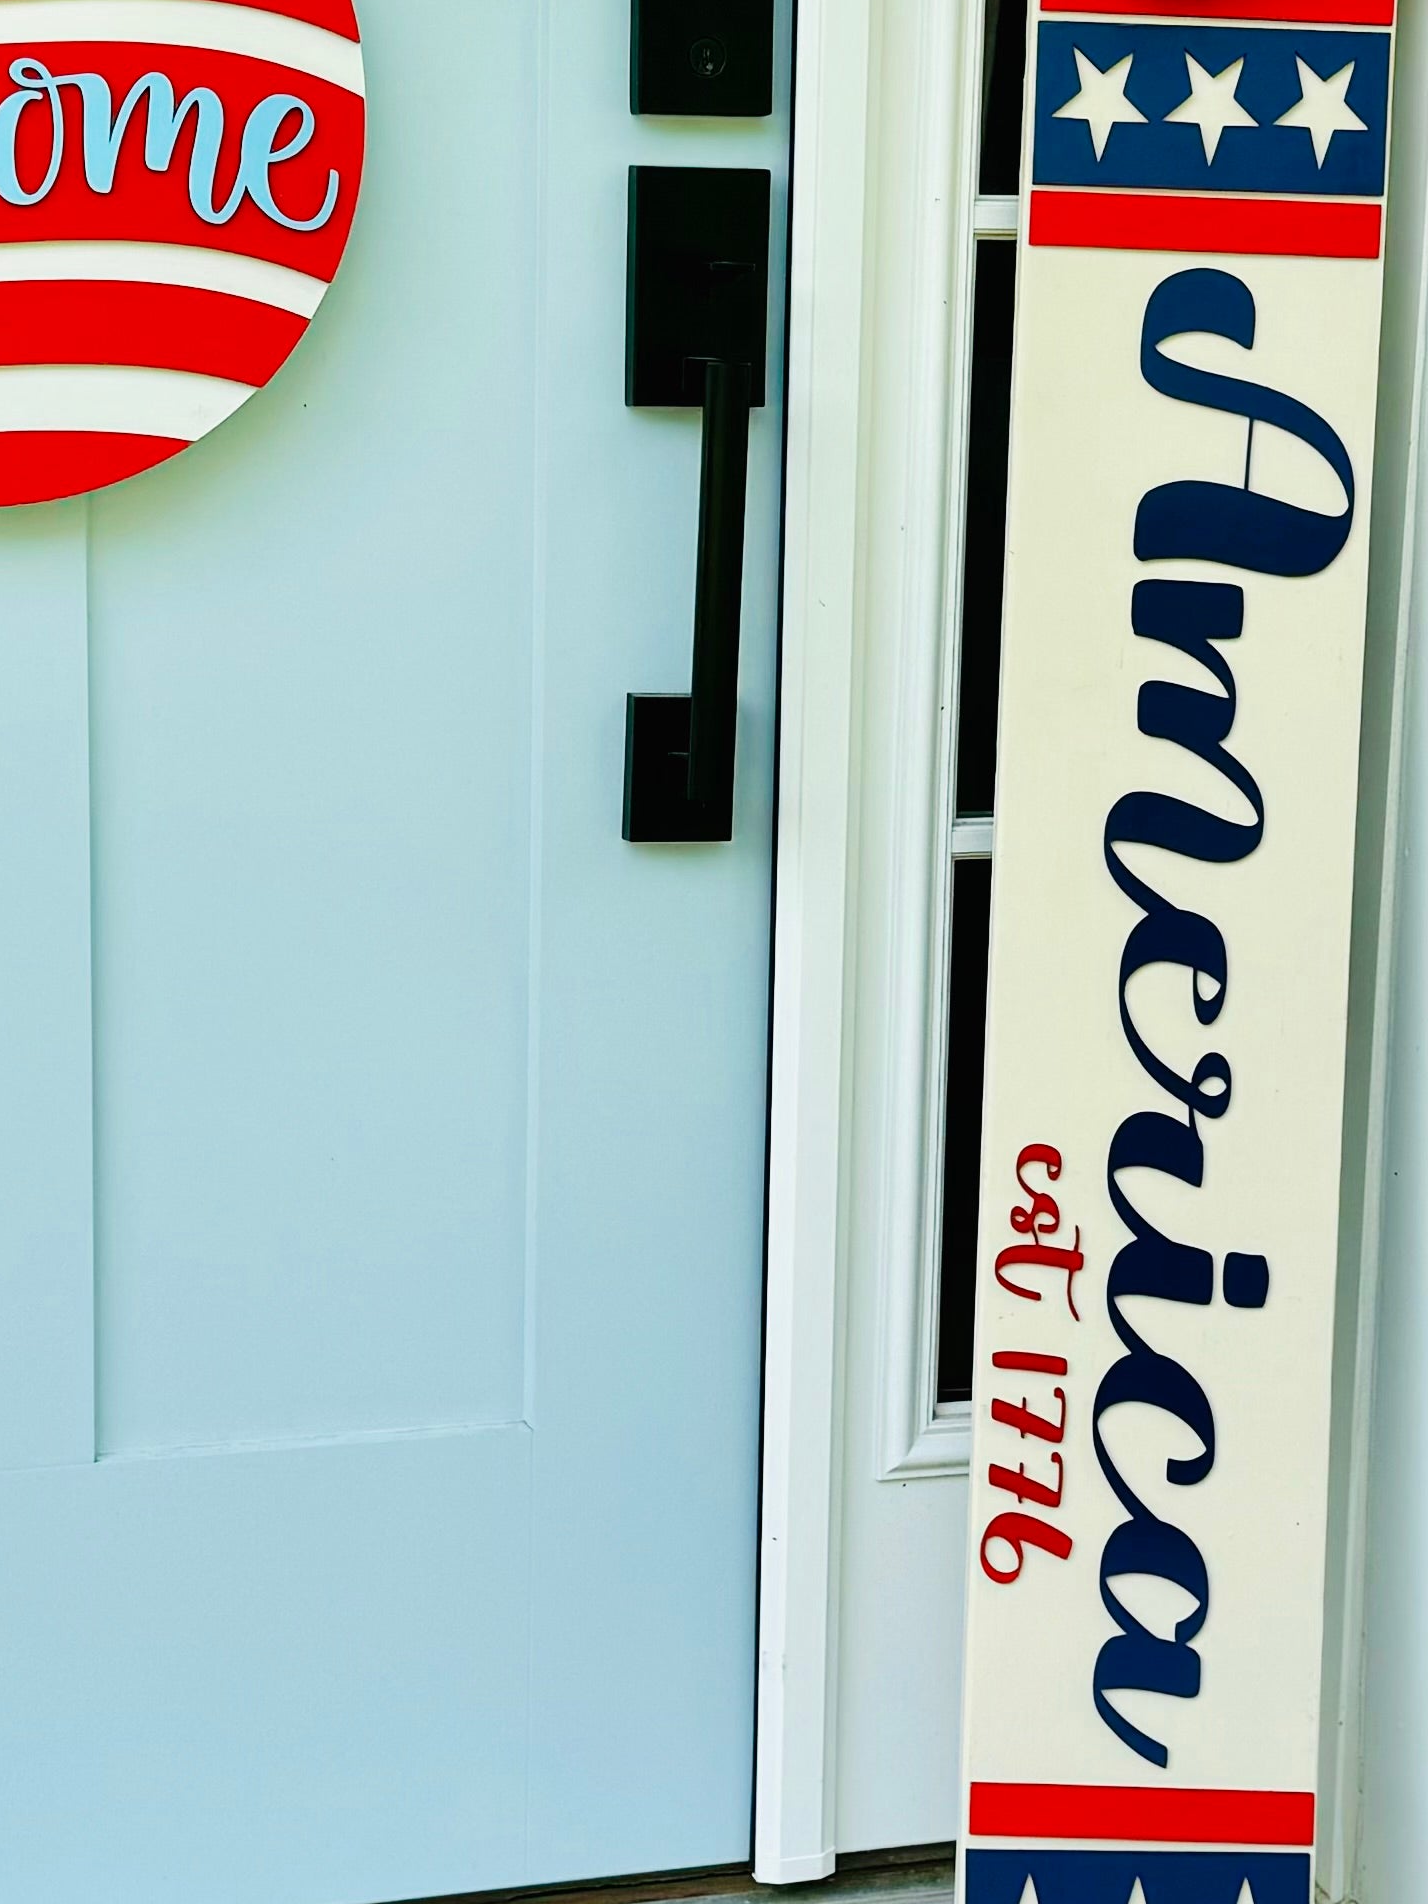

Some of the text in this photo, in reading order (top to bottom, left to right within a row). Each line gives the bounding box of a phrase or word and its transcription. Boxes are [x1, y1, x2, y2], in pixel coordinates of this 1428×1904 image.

[981, 1142, 1084, 1585] est 1776
[1092, 267, 1355, 1769] America
